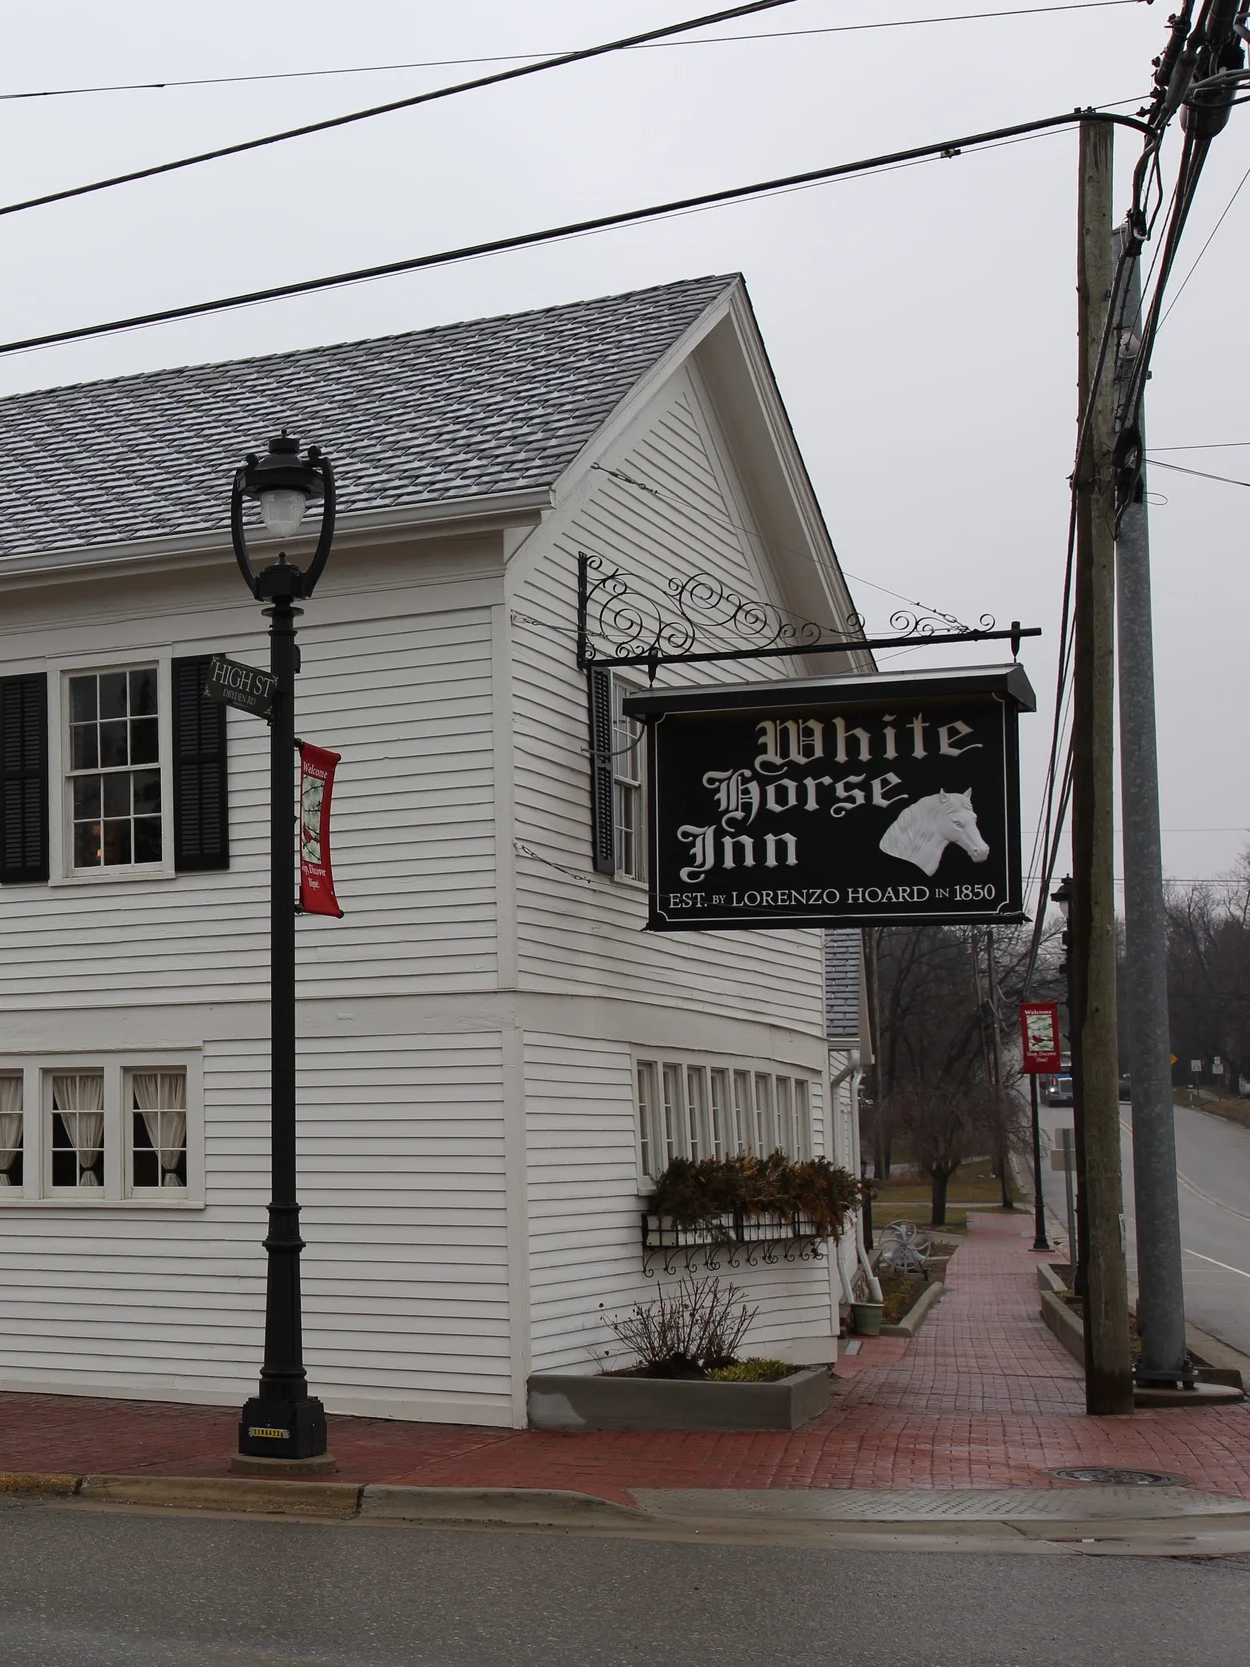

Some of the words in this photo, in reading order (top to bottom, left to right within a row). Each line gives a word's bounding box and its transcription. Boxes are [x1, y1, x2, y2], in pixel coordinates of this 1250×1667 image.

[212, 662, 253, 692] HIGH
[253, 675, 275, 698] ST
[222, 688, 248, 703] DRYDEN
[246, 696, 257, 706] RD
[754, 712, 983, 776] White
[303, 761, 328, 779] Welcome
[702, 768, 909, 832] Horse
[676, 824, 799, 883] Inn
[668, 892, 708, 909] EST.
[712, 894, 726, 904] BY
[730, 888, 840, 907] LORENZO
[847, 885, 930, 904] HOARD
[934, 887, 950, 899] IN
[953, 883, 996, 901] 1850
